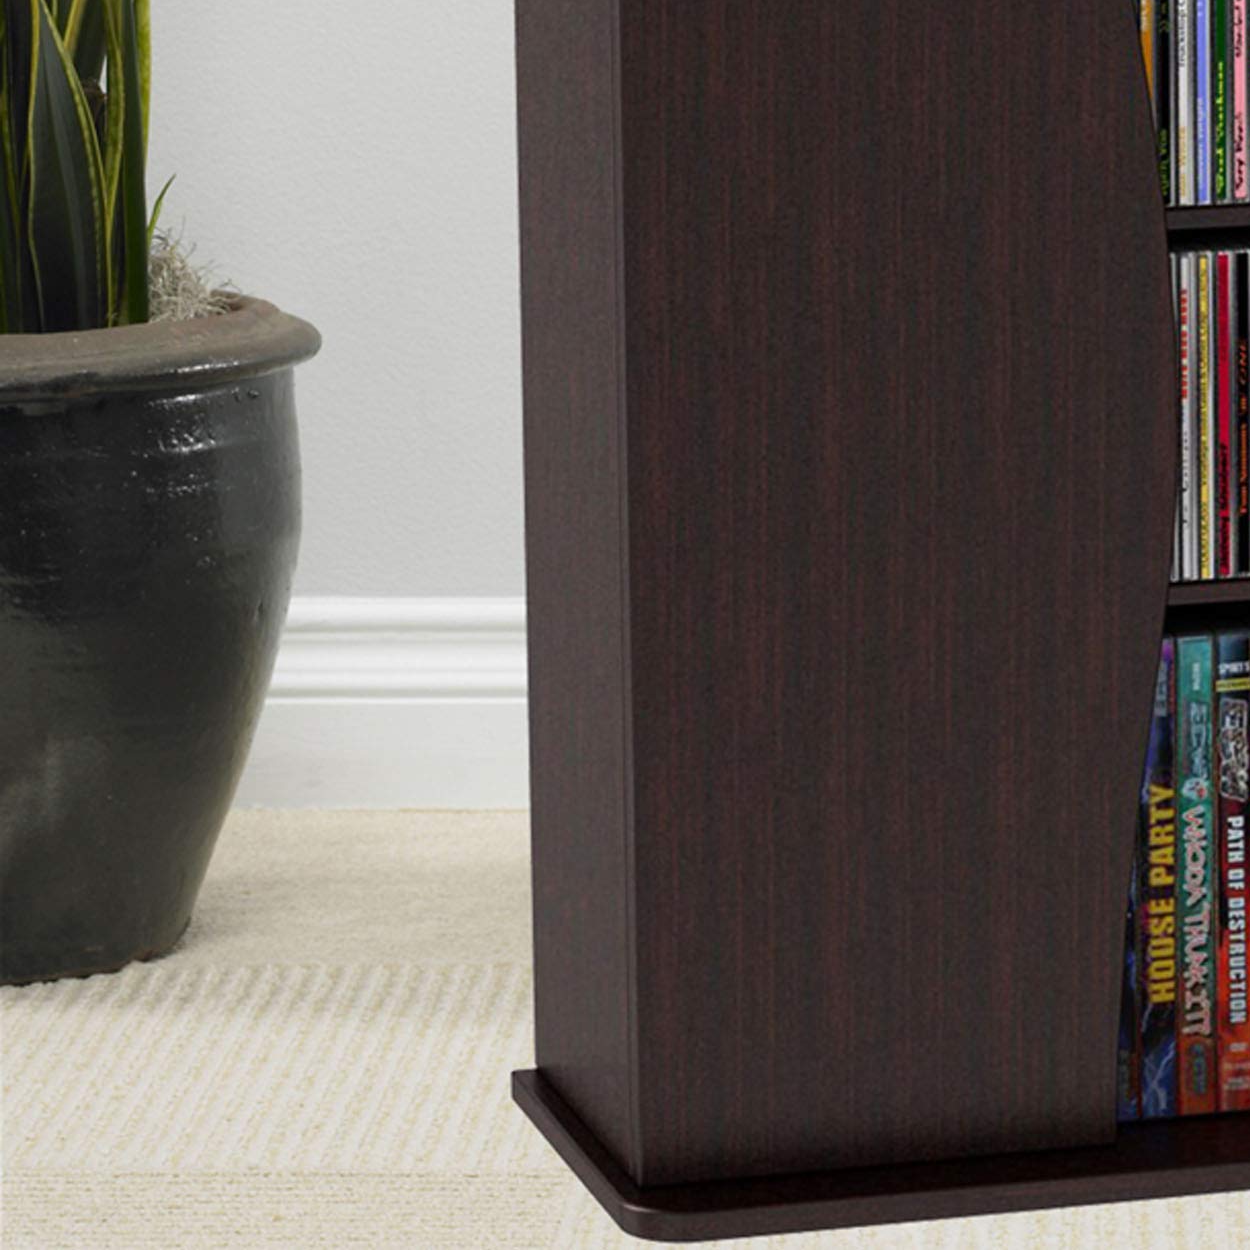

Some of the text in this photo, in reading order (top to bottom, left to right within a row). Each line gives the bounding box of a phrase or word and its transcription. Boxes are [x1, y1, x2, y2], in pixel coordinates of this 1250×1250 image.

[1177, 9, 1187, 67] Truckstop
[1149, 784, 1175, 1003] HOUSE PARTY
[1227, 814, 1247, 1024] PATH OF DESTRUCTION
